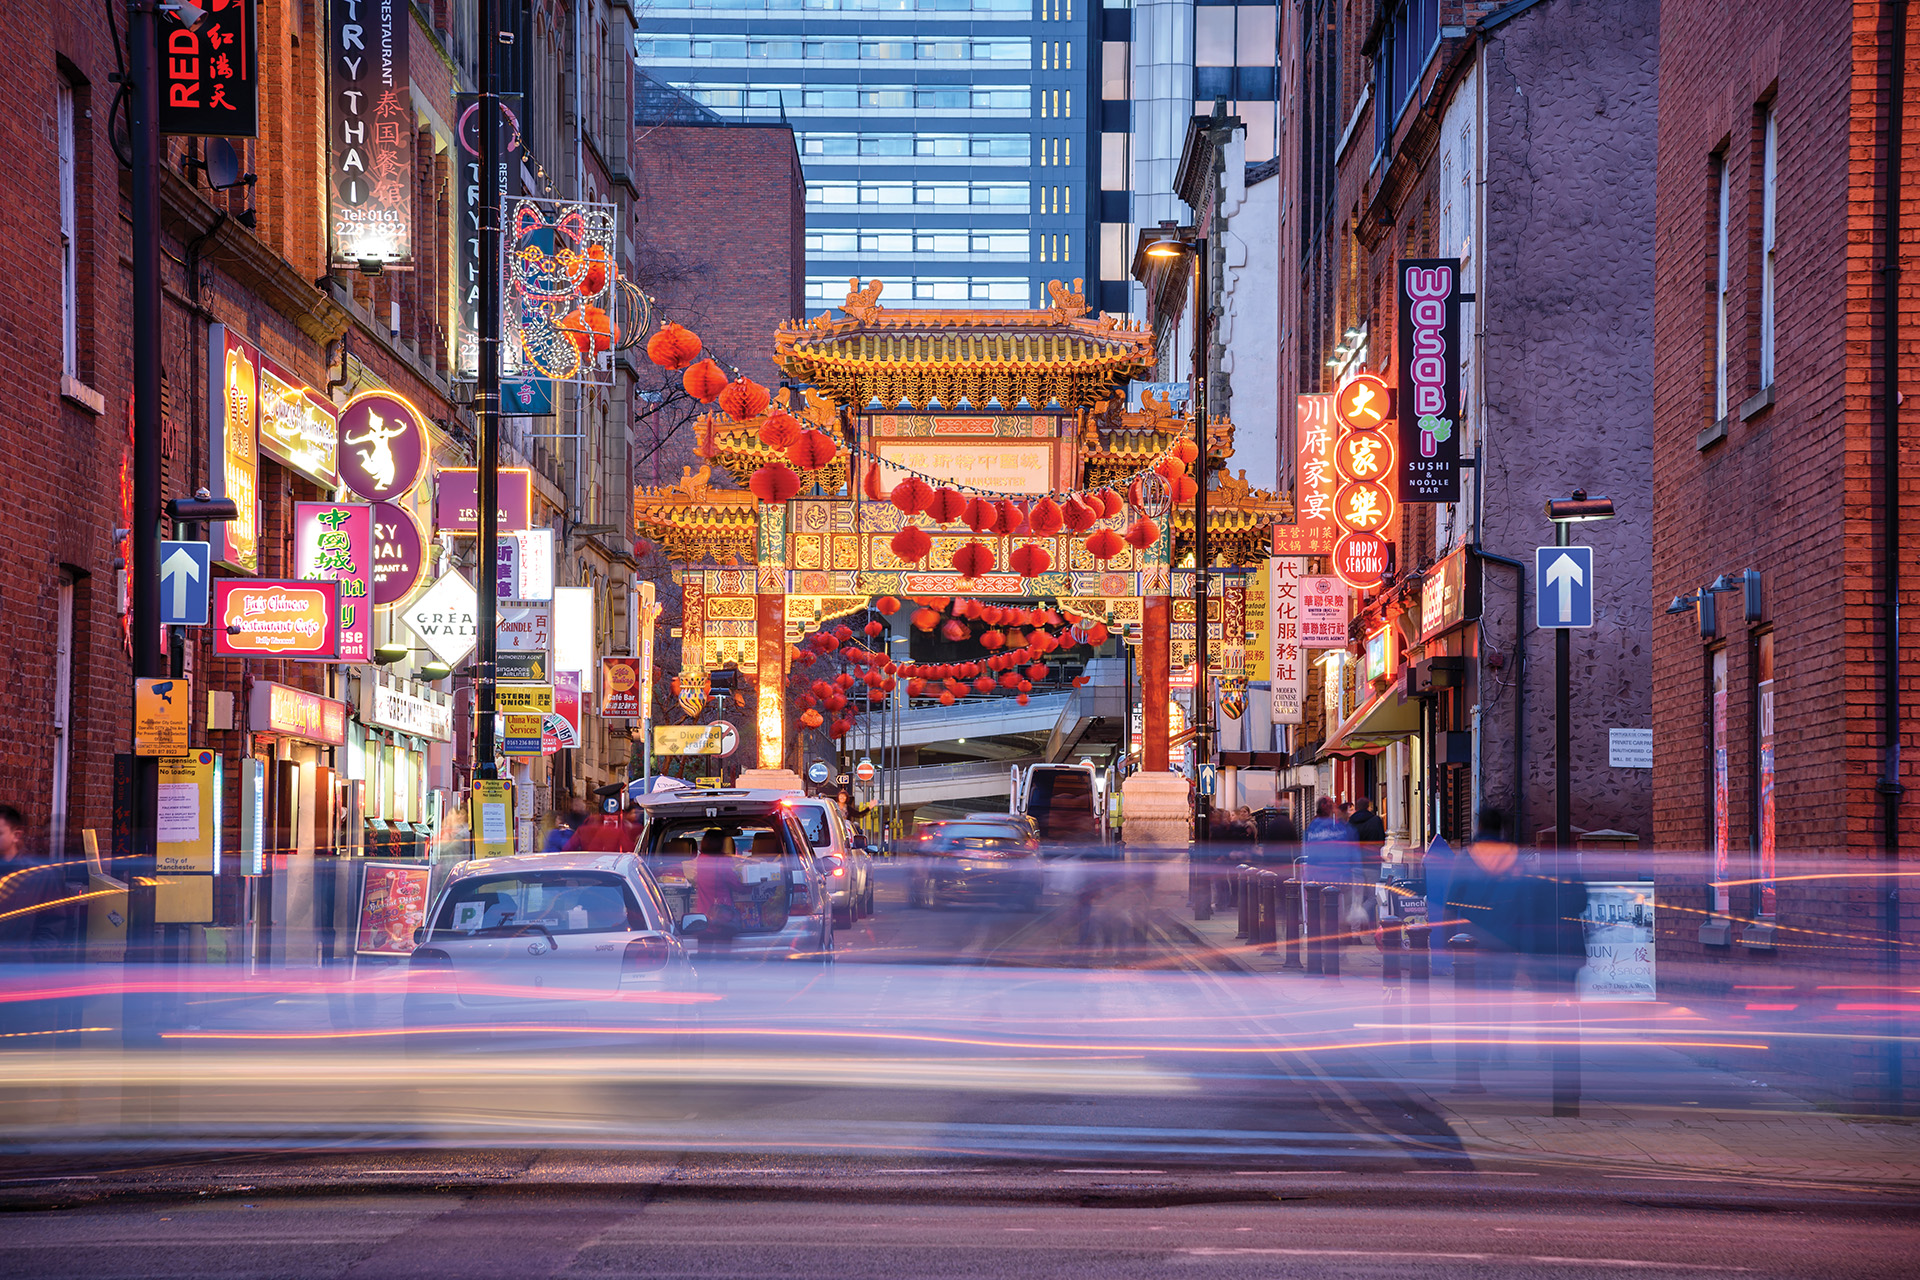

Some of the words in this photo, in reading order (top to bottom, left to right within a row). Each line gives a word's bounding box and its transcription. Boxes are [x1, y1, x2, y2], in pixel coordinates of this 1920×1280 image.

[168, 28, 200, 108] RED
[341, 210, 366, 221] Tel:
[367, 210, 399, 221] 0161
[336, 222, 364, 235] 228
[1301, 397, 1332, 520] 川府家宴
[1345, 383, 1382, 527] 大家樂
[1409, 461, 1449, 471] SUSHI
[965, 477, 1026, 486] MANCHESTER
[374, 523, 398, 540] RY
[315, 508, 356, 573] 中國城
[1349, 541, 1378, 557] HAPPY
[1345, 557, 1383, 573] SEASONS
[374, 574, 387, 582] AR
[268, 594, 309, 612] Chinese
[416, 612, 472, 623] GREA
[231, 616, 293, 634] Restaurant
[501, 622, 532, 633] BRINDLE
[513, 635, 520, 647] &
[507, 715, 525, 724] China
[526, 715, 540, 724] Visa
[509, 725, 537, 735] Services
[680, 731, 719, 739] Diverted
[685, 740, 714, 749] traffic
[159, 757, 197, 765] Suspension
[165, 857, 179, 866] City
[1400, 900, 1426, 908] Lunch
[461, 907, 476, 924] P
[595, 944, 615, 952] YARIS
[1586, 946, 1611, 958] JUN
[1617, 967, 1651, 976] SALON
